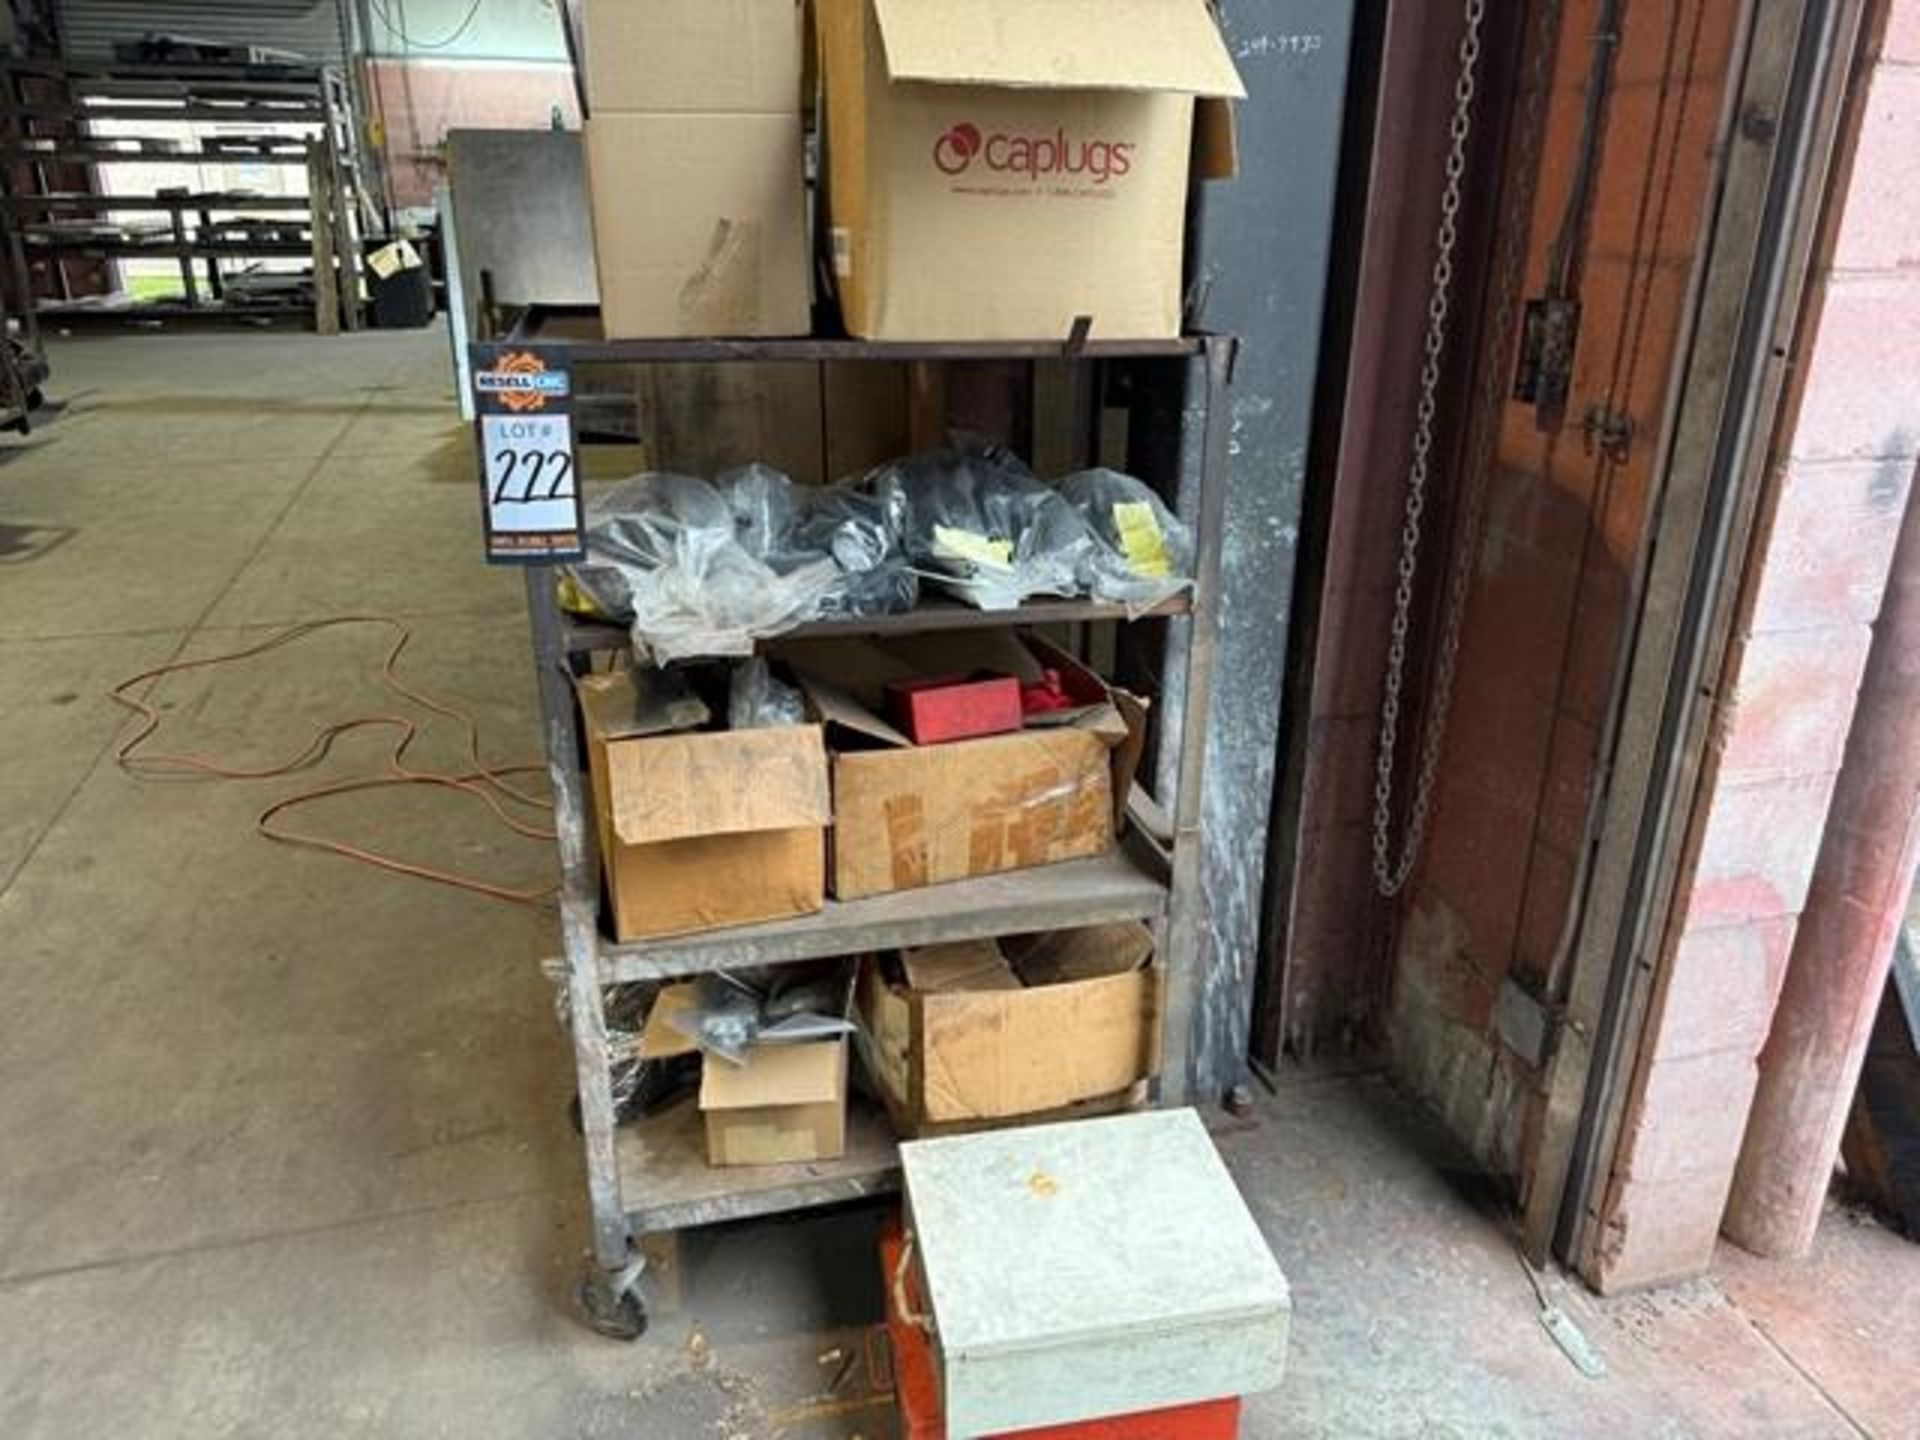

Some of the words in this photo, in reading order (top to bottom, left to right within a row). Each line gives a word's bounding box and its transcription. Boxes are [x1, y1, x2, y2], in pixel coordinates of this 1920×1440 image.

[985, 127, 1131, 184] caplugs
[500, 423, 536, 439] LOT
[493, 449, 577, 504] 222
